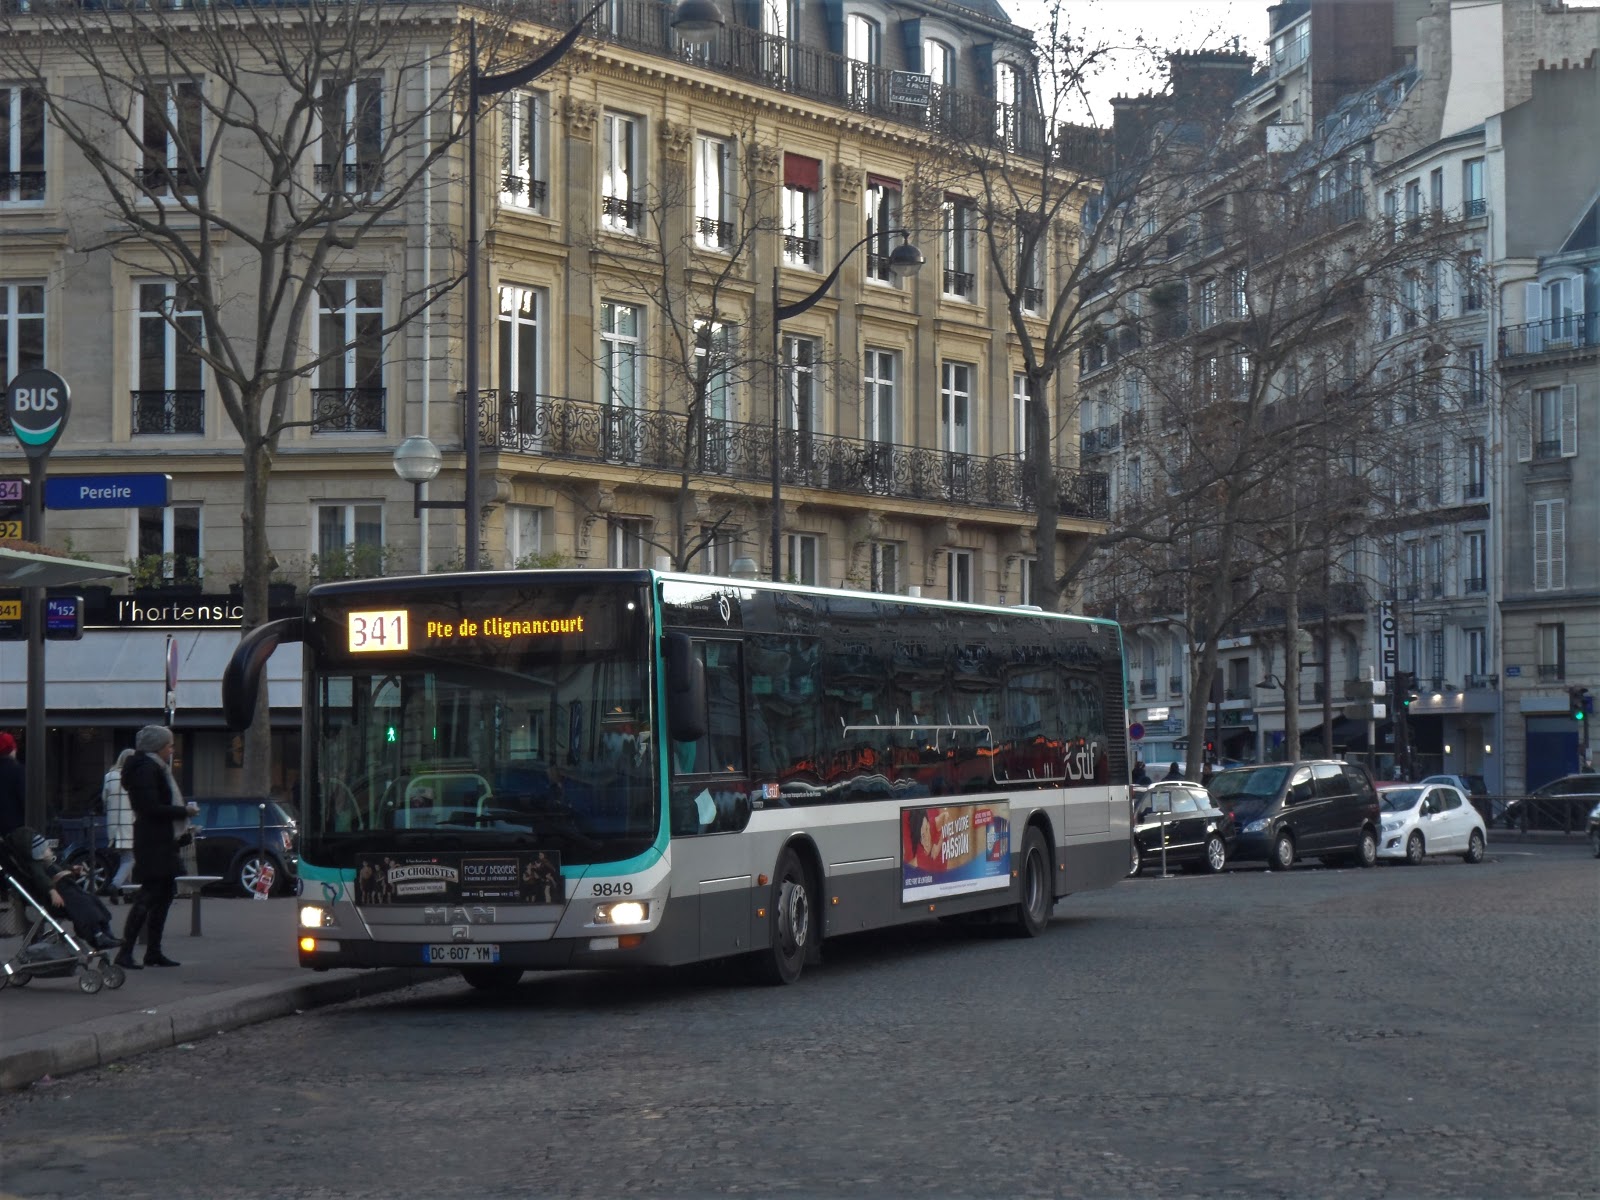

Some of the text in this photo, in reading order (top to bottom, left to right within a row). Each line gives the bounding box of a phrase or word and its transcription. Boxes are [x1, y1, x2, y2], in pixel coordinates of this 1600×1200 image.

[15, 388, 59, 412] BUS
[0, 482, 19, 498] 84
[80, 485, 132, 500] Pereire
[0, 522, 18, 538] 92
[353, 616, 403, 647] 341
[427, 615, 584, 638] Pte de Clignancourt
[1382, 602, 1396, 679] HOTEL
[391, 867, 455, 880] LES CHORISTES
[593, 882, 633, 896] 9849
[424, 906, 497, 924] MAN
